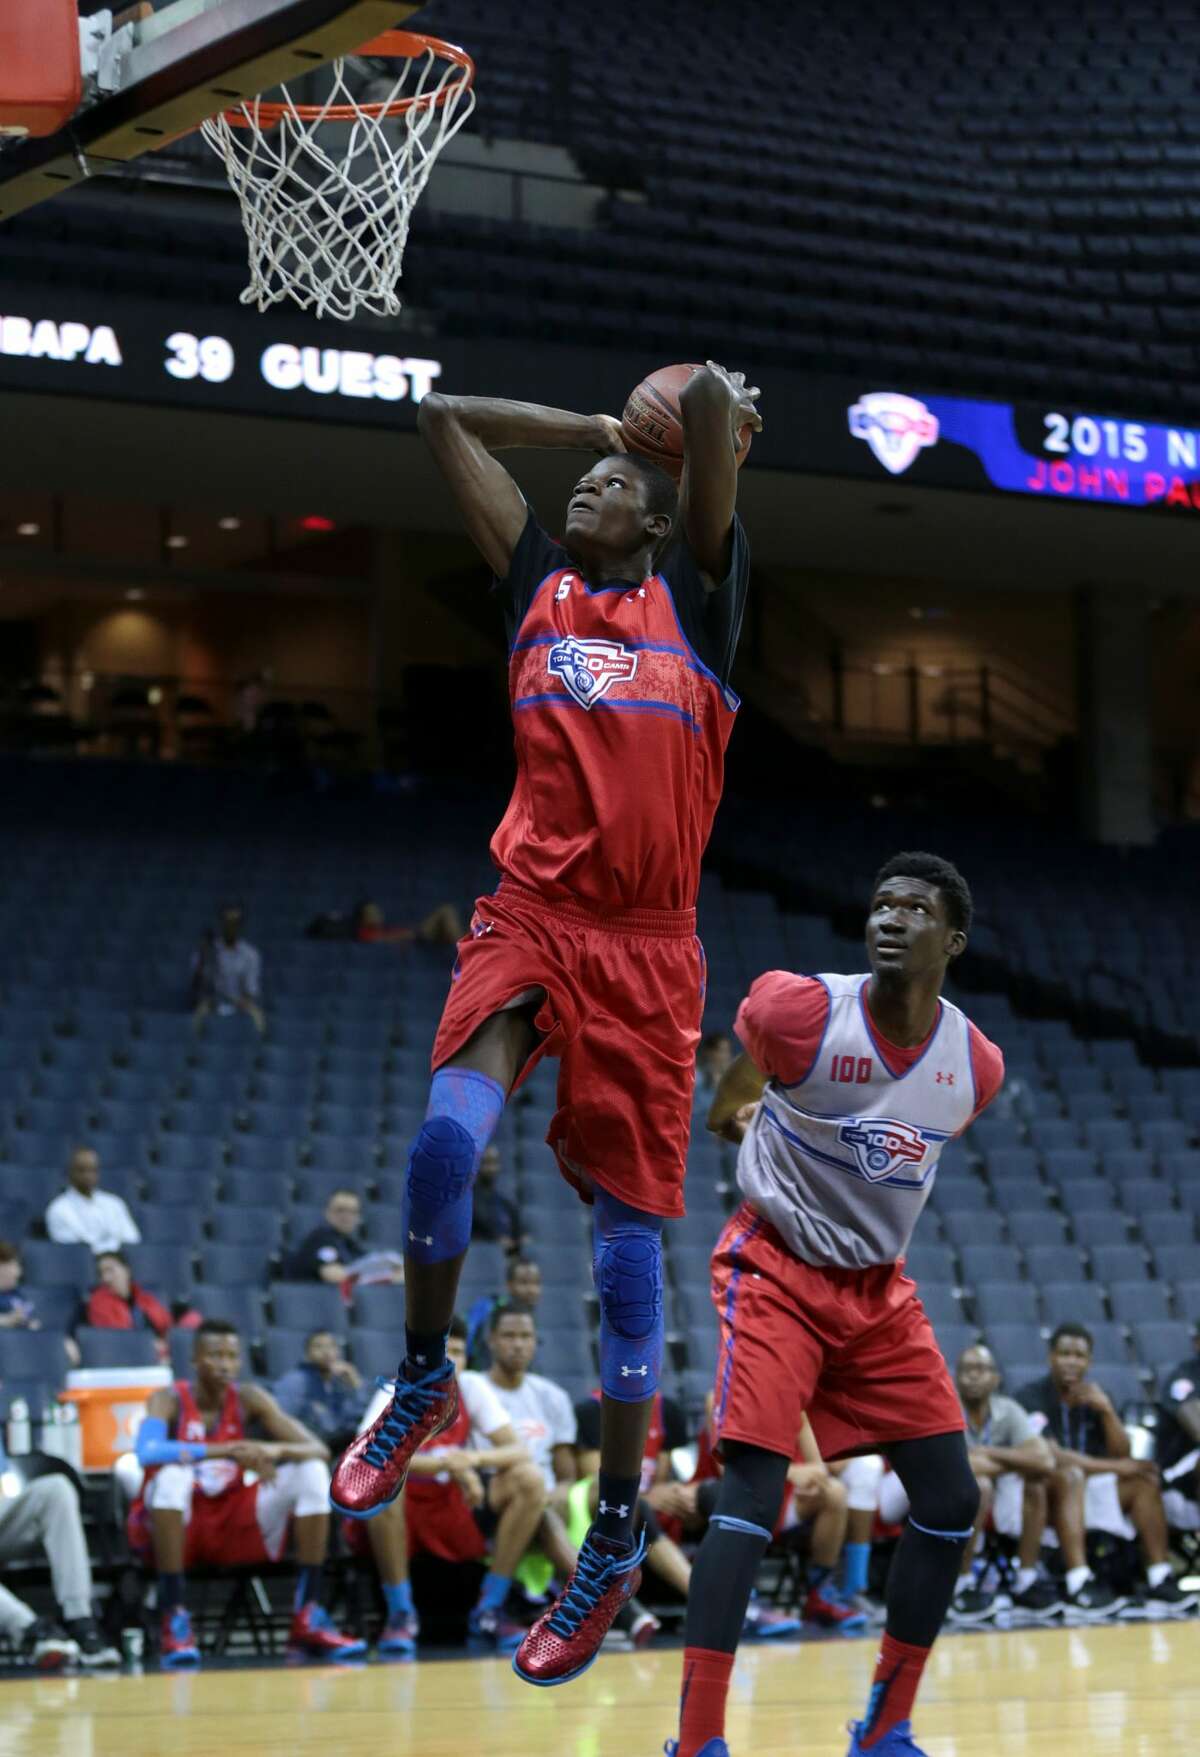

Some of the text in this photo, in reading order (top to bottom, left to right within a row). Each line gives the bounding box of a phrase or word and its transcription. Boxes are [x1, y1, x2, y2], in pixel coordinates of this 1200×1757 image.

[0, 315, 441, 402] BAPA 39 GUEST
[1044, 413, 1147, 462] 2015
[1028, 459, 1128, 498] JOHN
[830, 1055, 872, 1084] 100
[867, 1133, 901, 1150] 100
